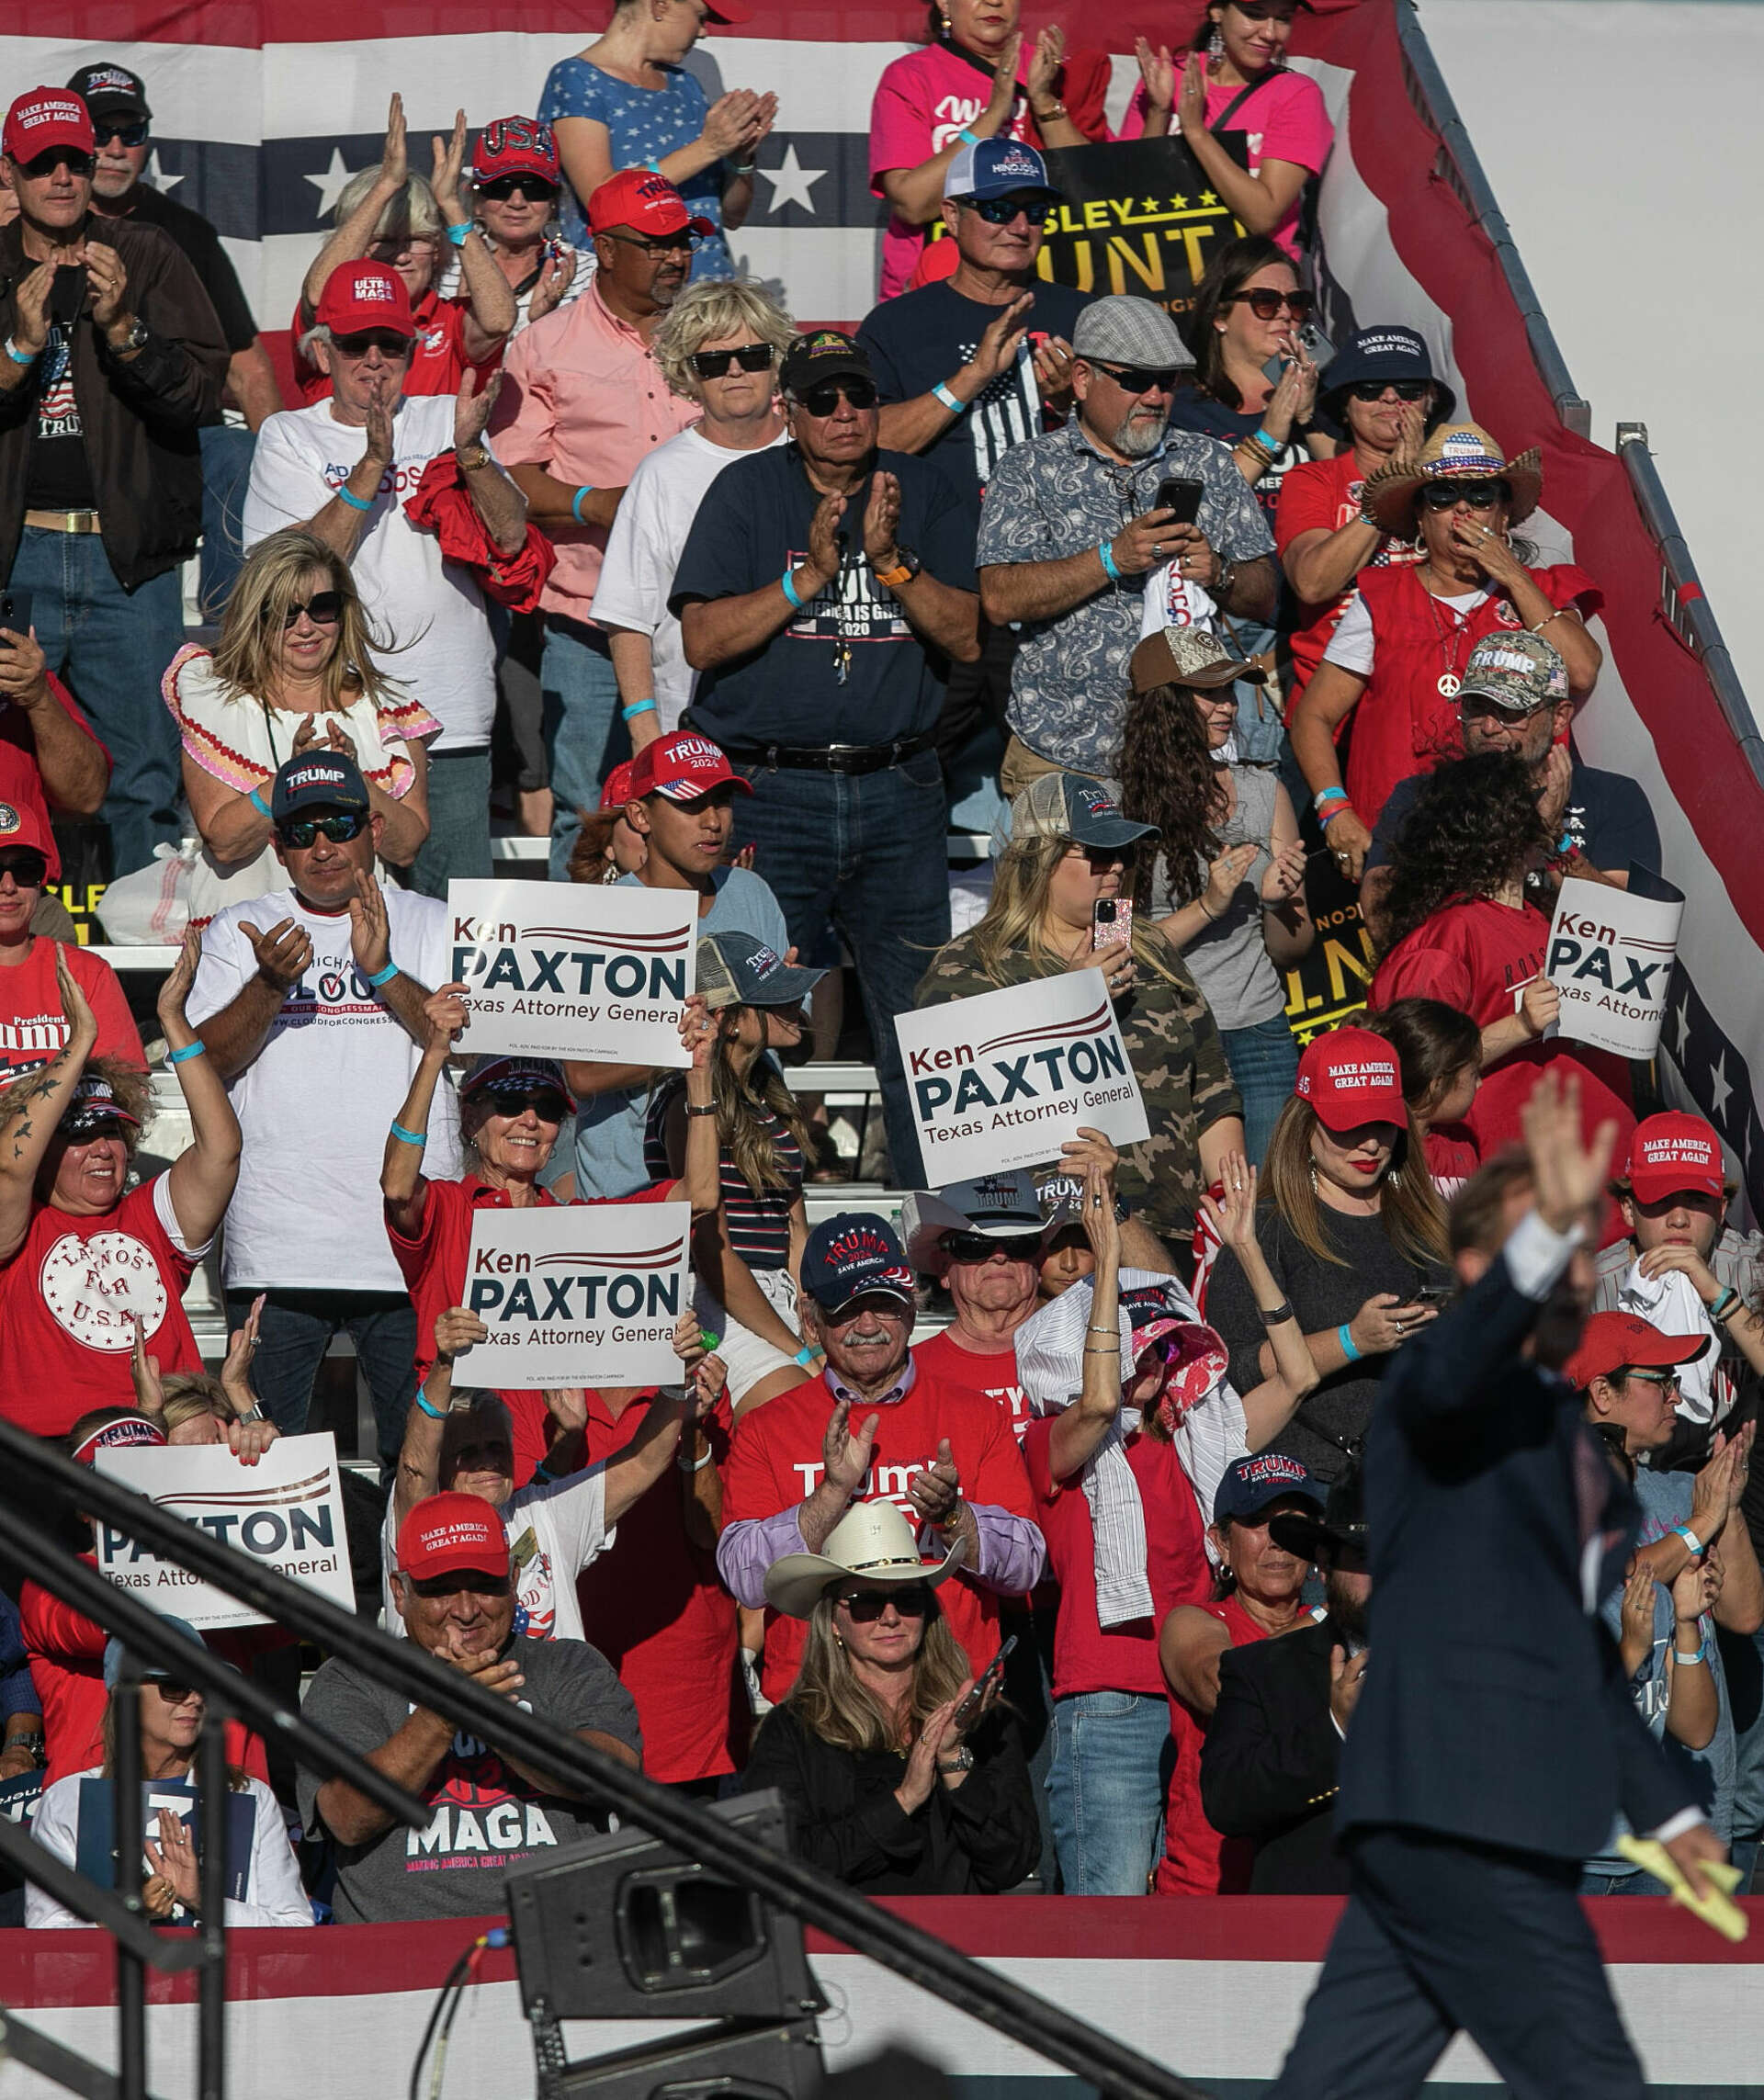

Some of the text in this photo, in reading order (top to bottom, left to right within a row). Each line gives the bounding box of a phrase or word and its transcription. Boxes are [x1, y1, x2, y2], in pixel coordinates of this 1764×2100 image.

[17, 101, 82, 120] MAKE AMERICA
[23, 112, 80, 130] GREAT AGAIN
[482, 118, 555, 163] USA
[1043, 198, 1134, 234] SLEY
[1036, 225, 1215, 295] UNT
[355, 279, 391, 289] ULTRA
[355, 289, 392, 300] MAGA
[1358, 334, 1385, 349] MAKE
[1363, 344, 1394, 355] GREAT
[1447, 446, 1481, 455] TRUMP
[1474, 650, 1535, 673] TRUMP
[286, 768, 345, 788] TRUMP
[454, 917, 516, 943] Ken
[1556, 911, 1616, 945] Ken
[451, 946, 685, 1000] PAXTON
[14, 1014, 65, 1026] President
[512, 998, 600, 1022] Attorney
[607, 1004, 684, 1023] General
[909, 1044, 974, 1075] Ken
[915, 1035, 1126, 1122] PAXTON
[1329, 1062, 1395, 1077] MAKE AMERICA
[1335, 1075, 1393, 1089] GREAT AGAIN
[924, 1082, 1134, 1144] Texas Attorney General
[1644, 1139, 1712, 1154] MAKE AMERICA
[1647, 1151, 1709, 1165] GREAT AGAIN
[1052, 1200, 1081, 1211] 224
[824, 1232, 889, 1266] TRUMP
[475, 1248, 531, 1273] Ken
[838, 1262, 855, 1274] SAVE
[469, 1273, 679, 1322] PAXTON
[527, 1328, 605, 1346] Attorney
[1237, 1458, 1306, 1481] TRUMP
[1251, 1473, 1270, 1483] SAVE
[421, 1522, 489, 1542] MAKE AMERICA
[426, 1535, 458, 1551] GREAT
[105, 1571, 151, 1587] Texas
[407, 1802, 558, 1856] MAGA
[441, 1856, 478, 1870] AMERICA
